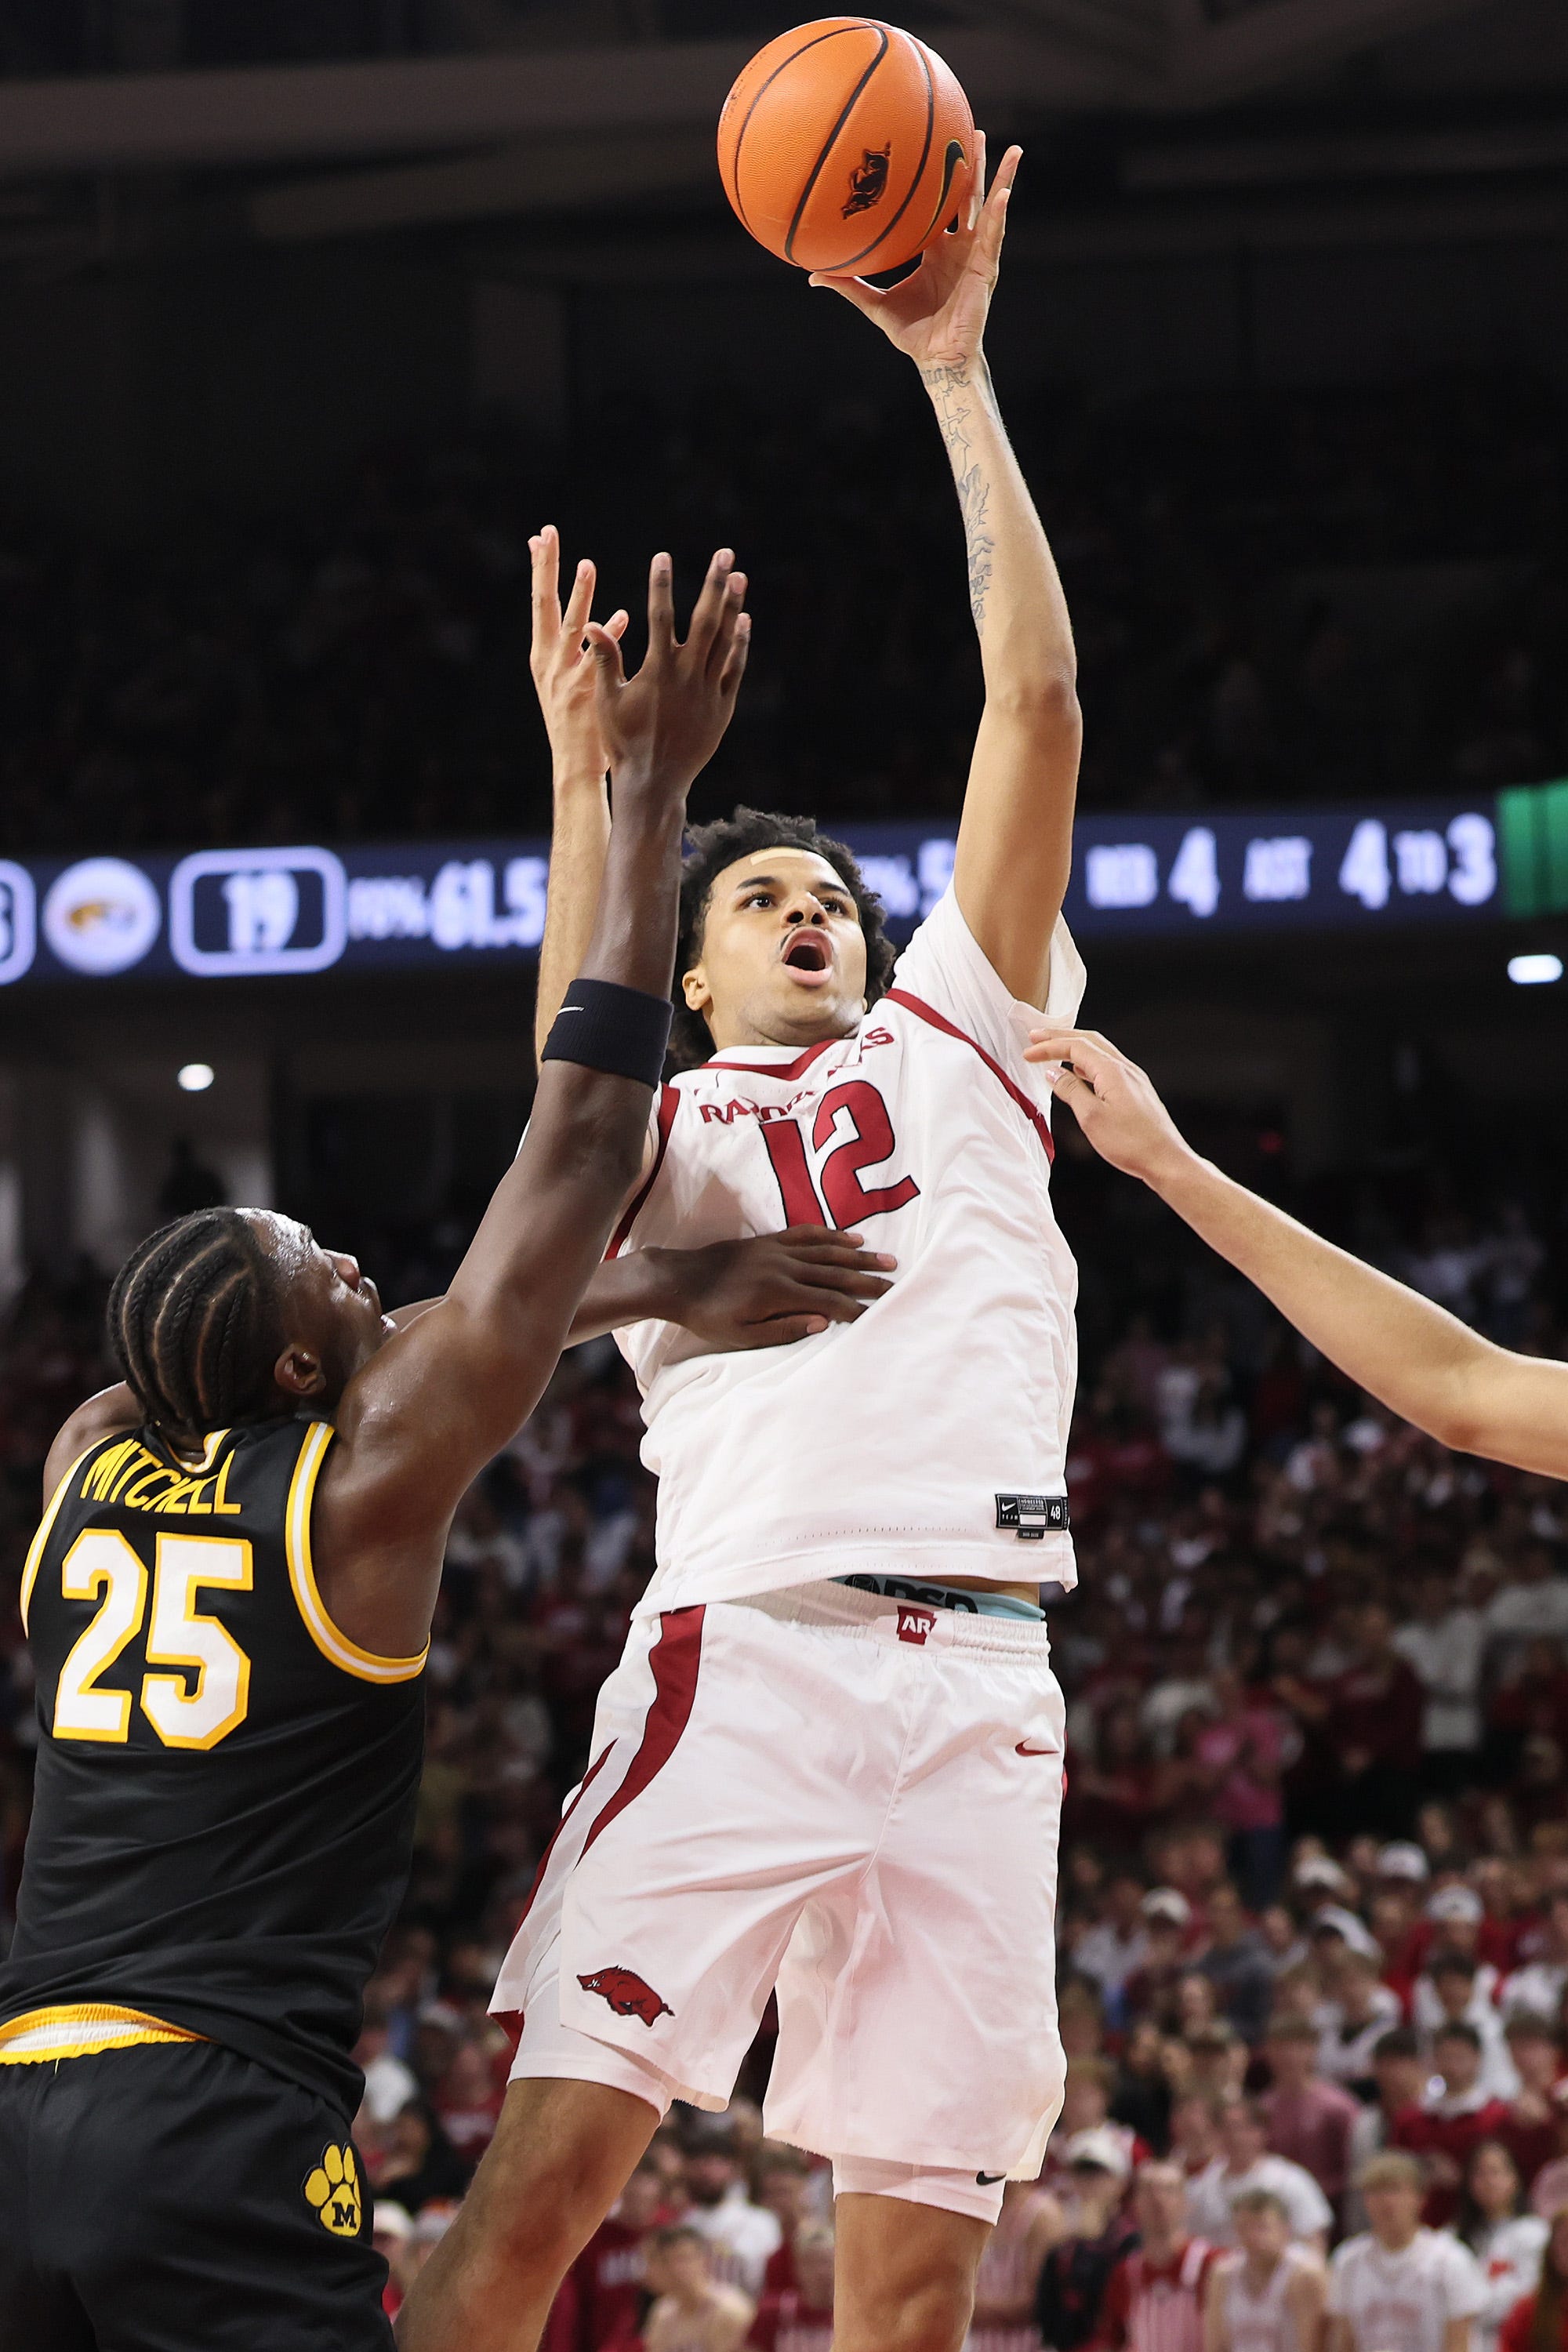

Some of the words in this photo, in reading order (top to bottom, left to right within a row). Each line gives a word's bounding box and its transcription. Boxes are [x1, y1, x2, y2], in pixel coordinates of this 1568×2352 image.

[1167, 826, 1221, 918] 4
[1338, 818, 1392, 910] 4
[1446, 812, 1497, 906] 3
[221, 869, 299, 952] 19
[759, 1079, 921, 1232] 12
[1051, 1505, 1061, 1520] 48
[53, 1527, 254, 1751] 25
[902, 1614, 931, 1635] AR
[331, 2201, 357, 2229] M
